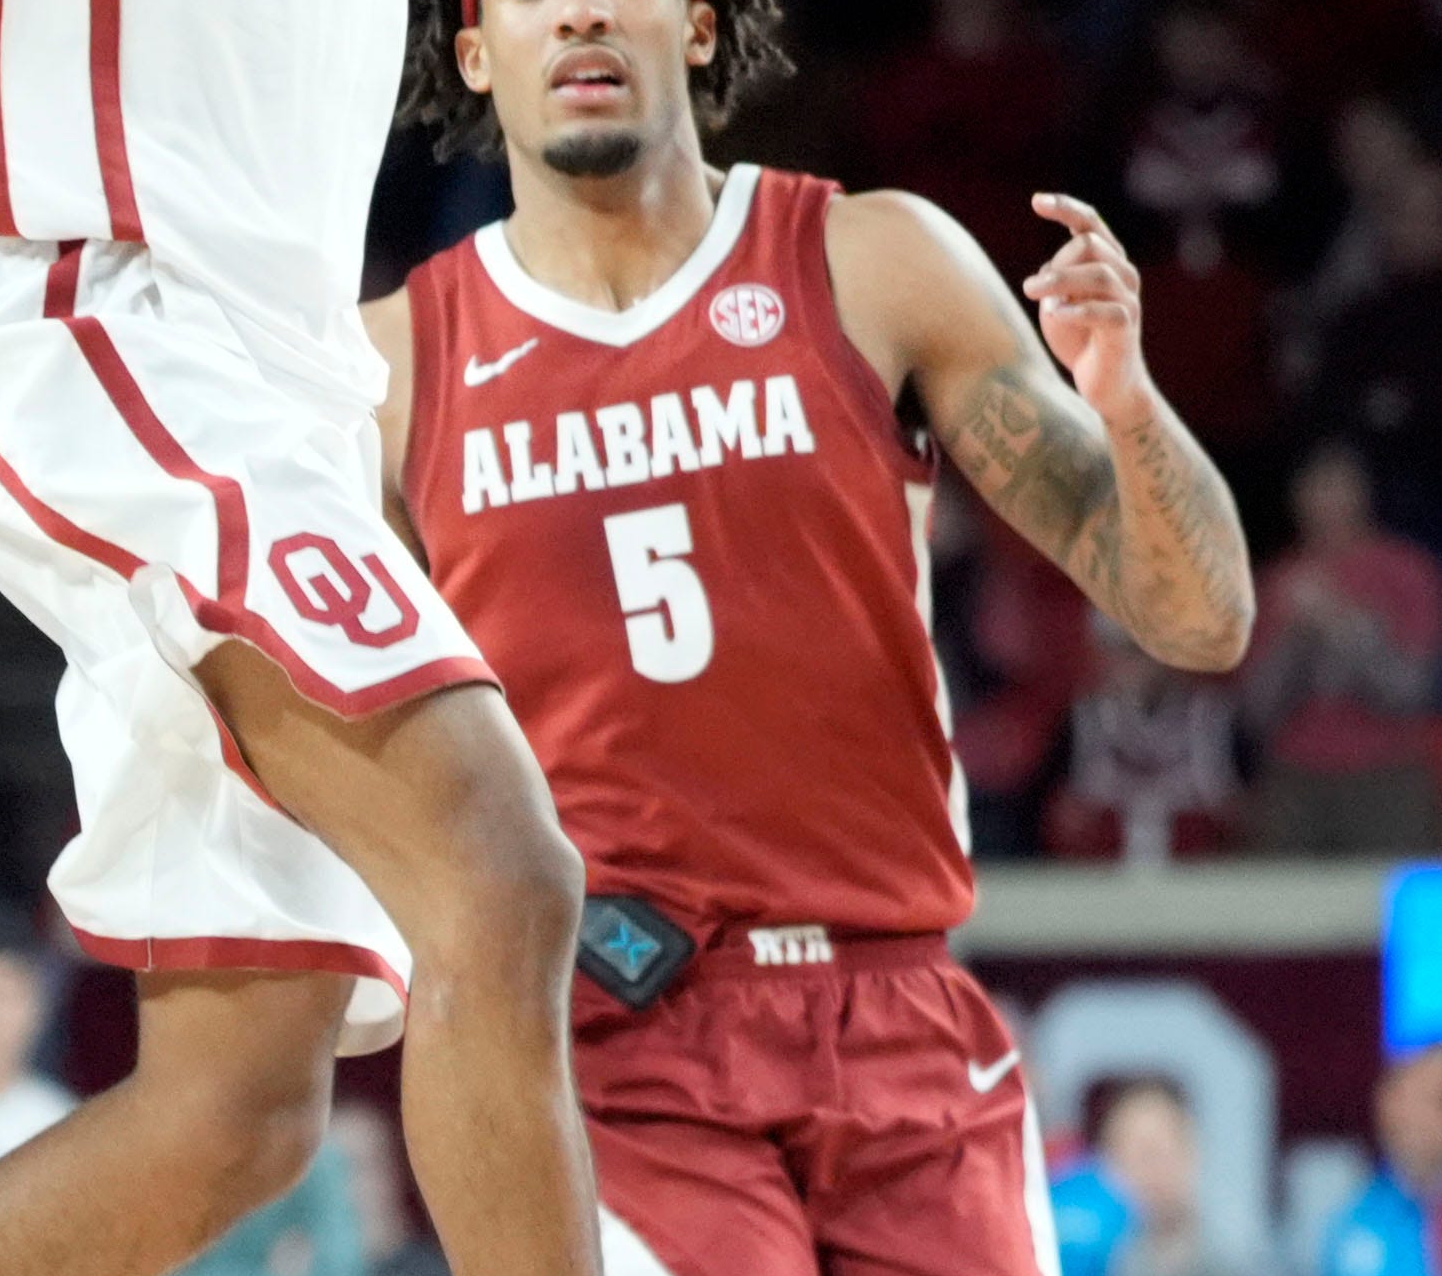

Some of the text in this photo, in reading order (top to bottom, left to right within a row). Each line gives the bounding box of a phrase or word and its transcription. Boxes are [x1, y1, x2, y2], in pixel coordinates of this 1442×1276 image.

[712, 285, 782, 342] SEC
[462, 373, 816, 515] ALABAMA
[267, 531, 420, 650] OU
[603, 502, 715, 684] 5
